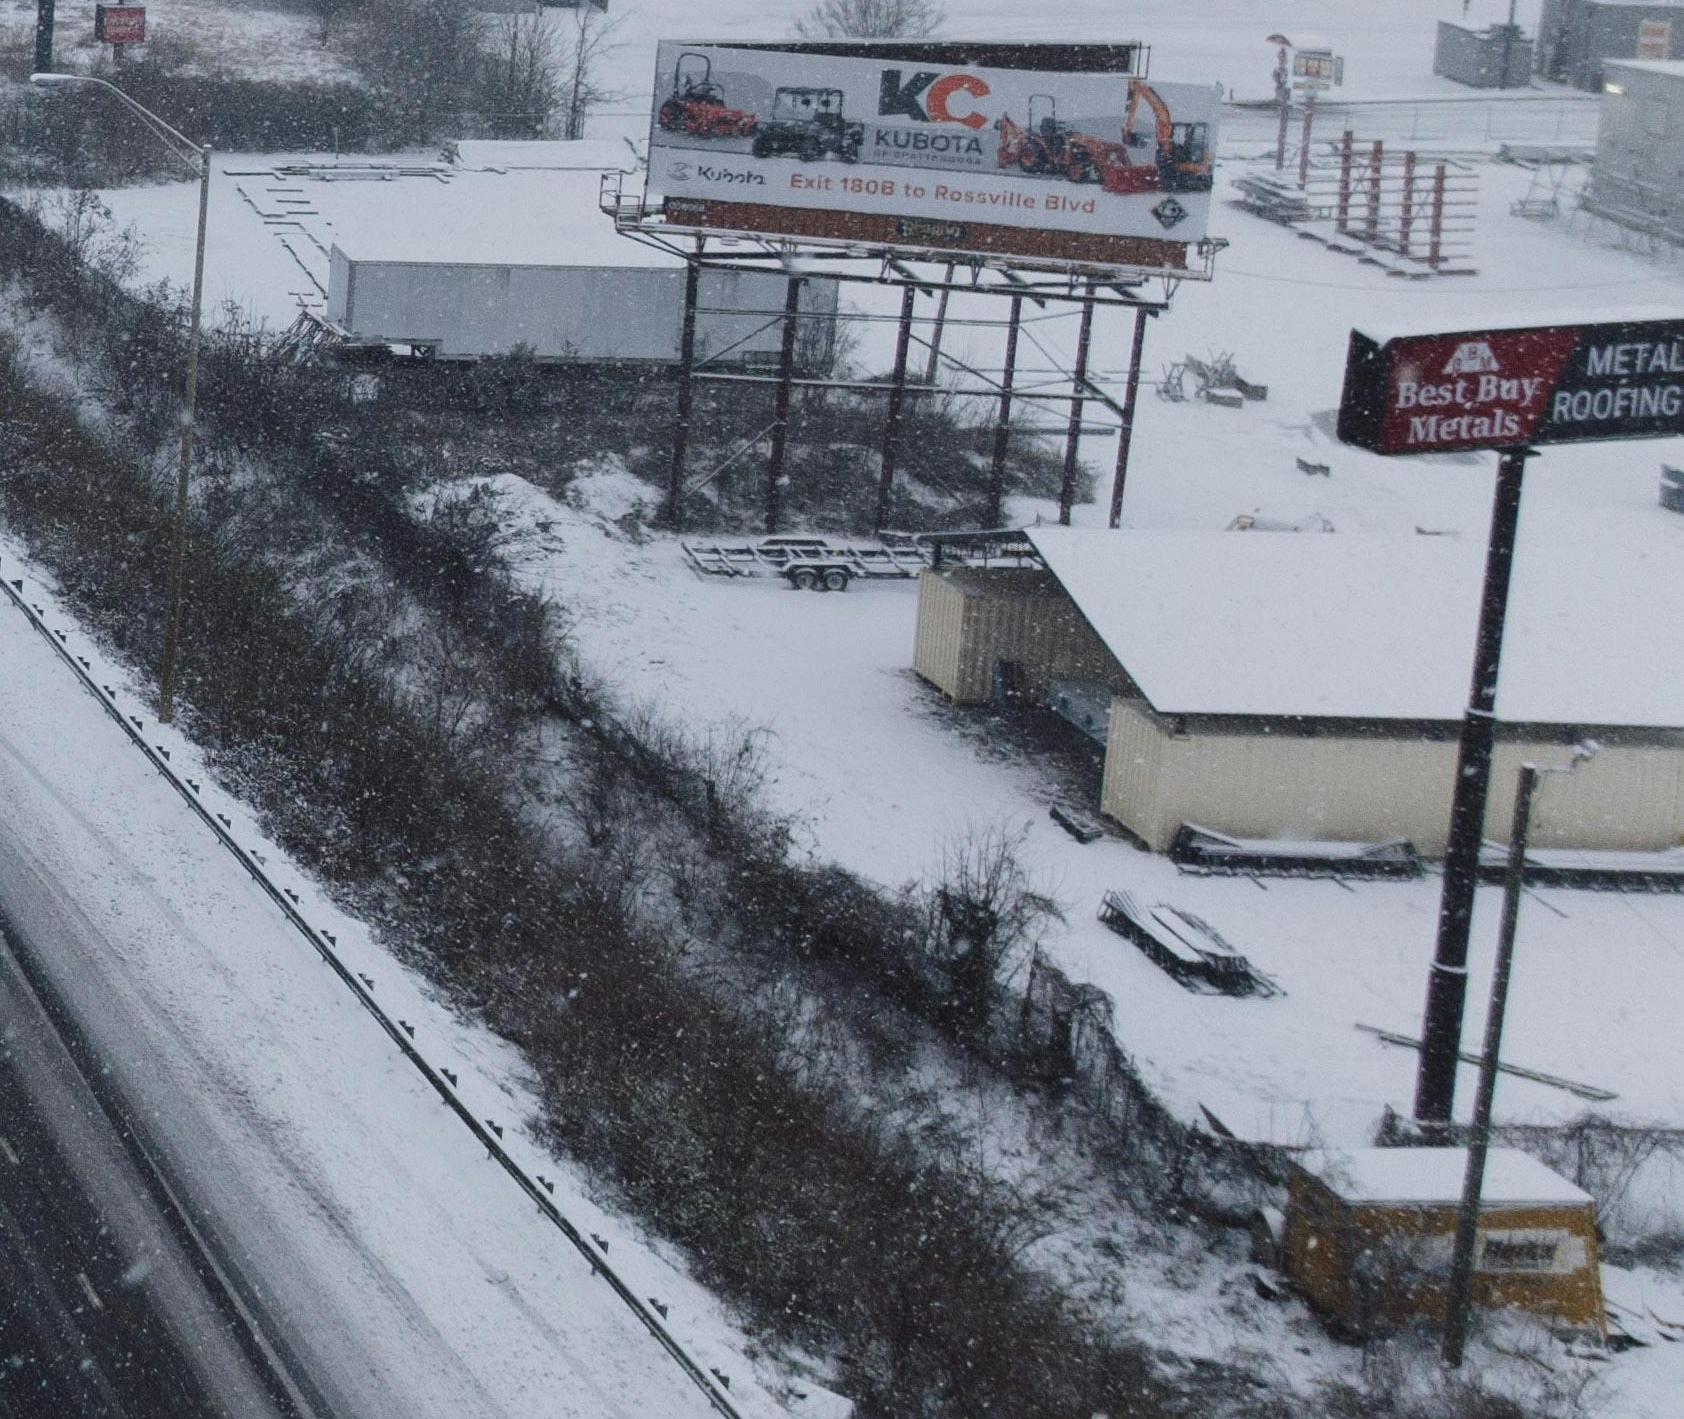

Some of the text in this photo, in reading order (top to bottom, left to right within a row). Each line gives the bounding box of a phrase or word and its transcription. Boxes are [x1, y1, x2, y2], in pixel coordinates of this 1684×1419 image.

[879, 68, 991, 130] KC
[875, 130, 983, 155] KUBOTA
[698, 165, 766, 185] Kubota
[790, 173, 1097, 215] Exit 180B to Rossville Blvd
[1586, 341, 1684, 377] METAL
[1396, 375, 1544, 409] Best Buy
[1552, 384, 1683, 423] ROOFING
[1407, 409, 1520, 444] Metals
